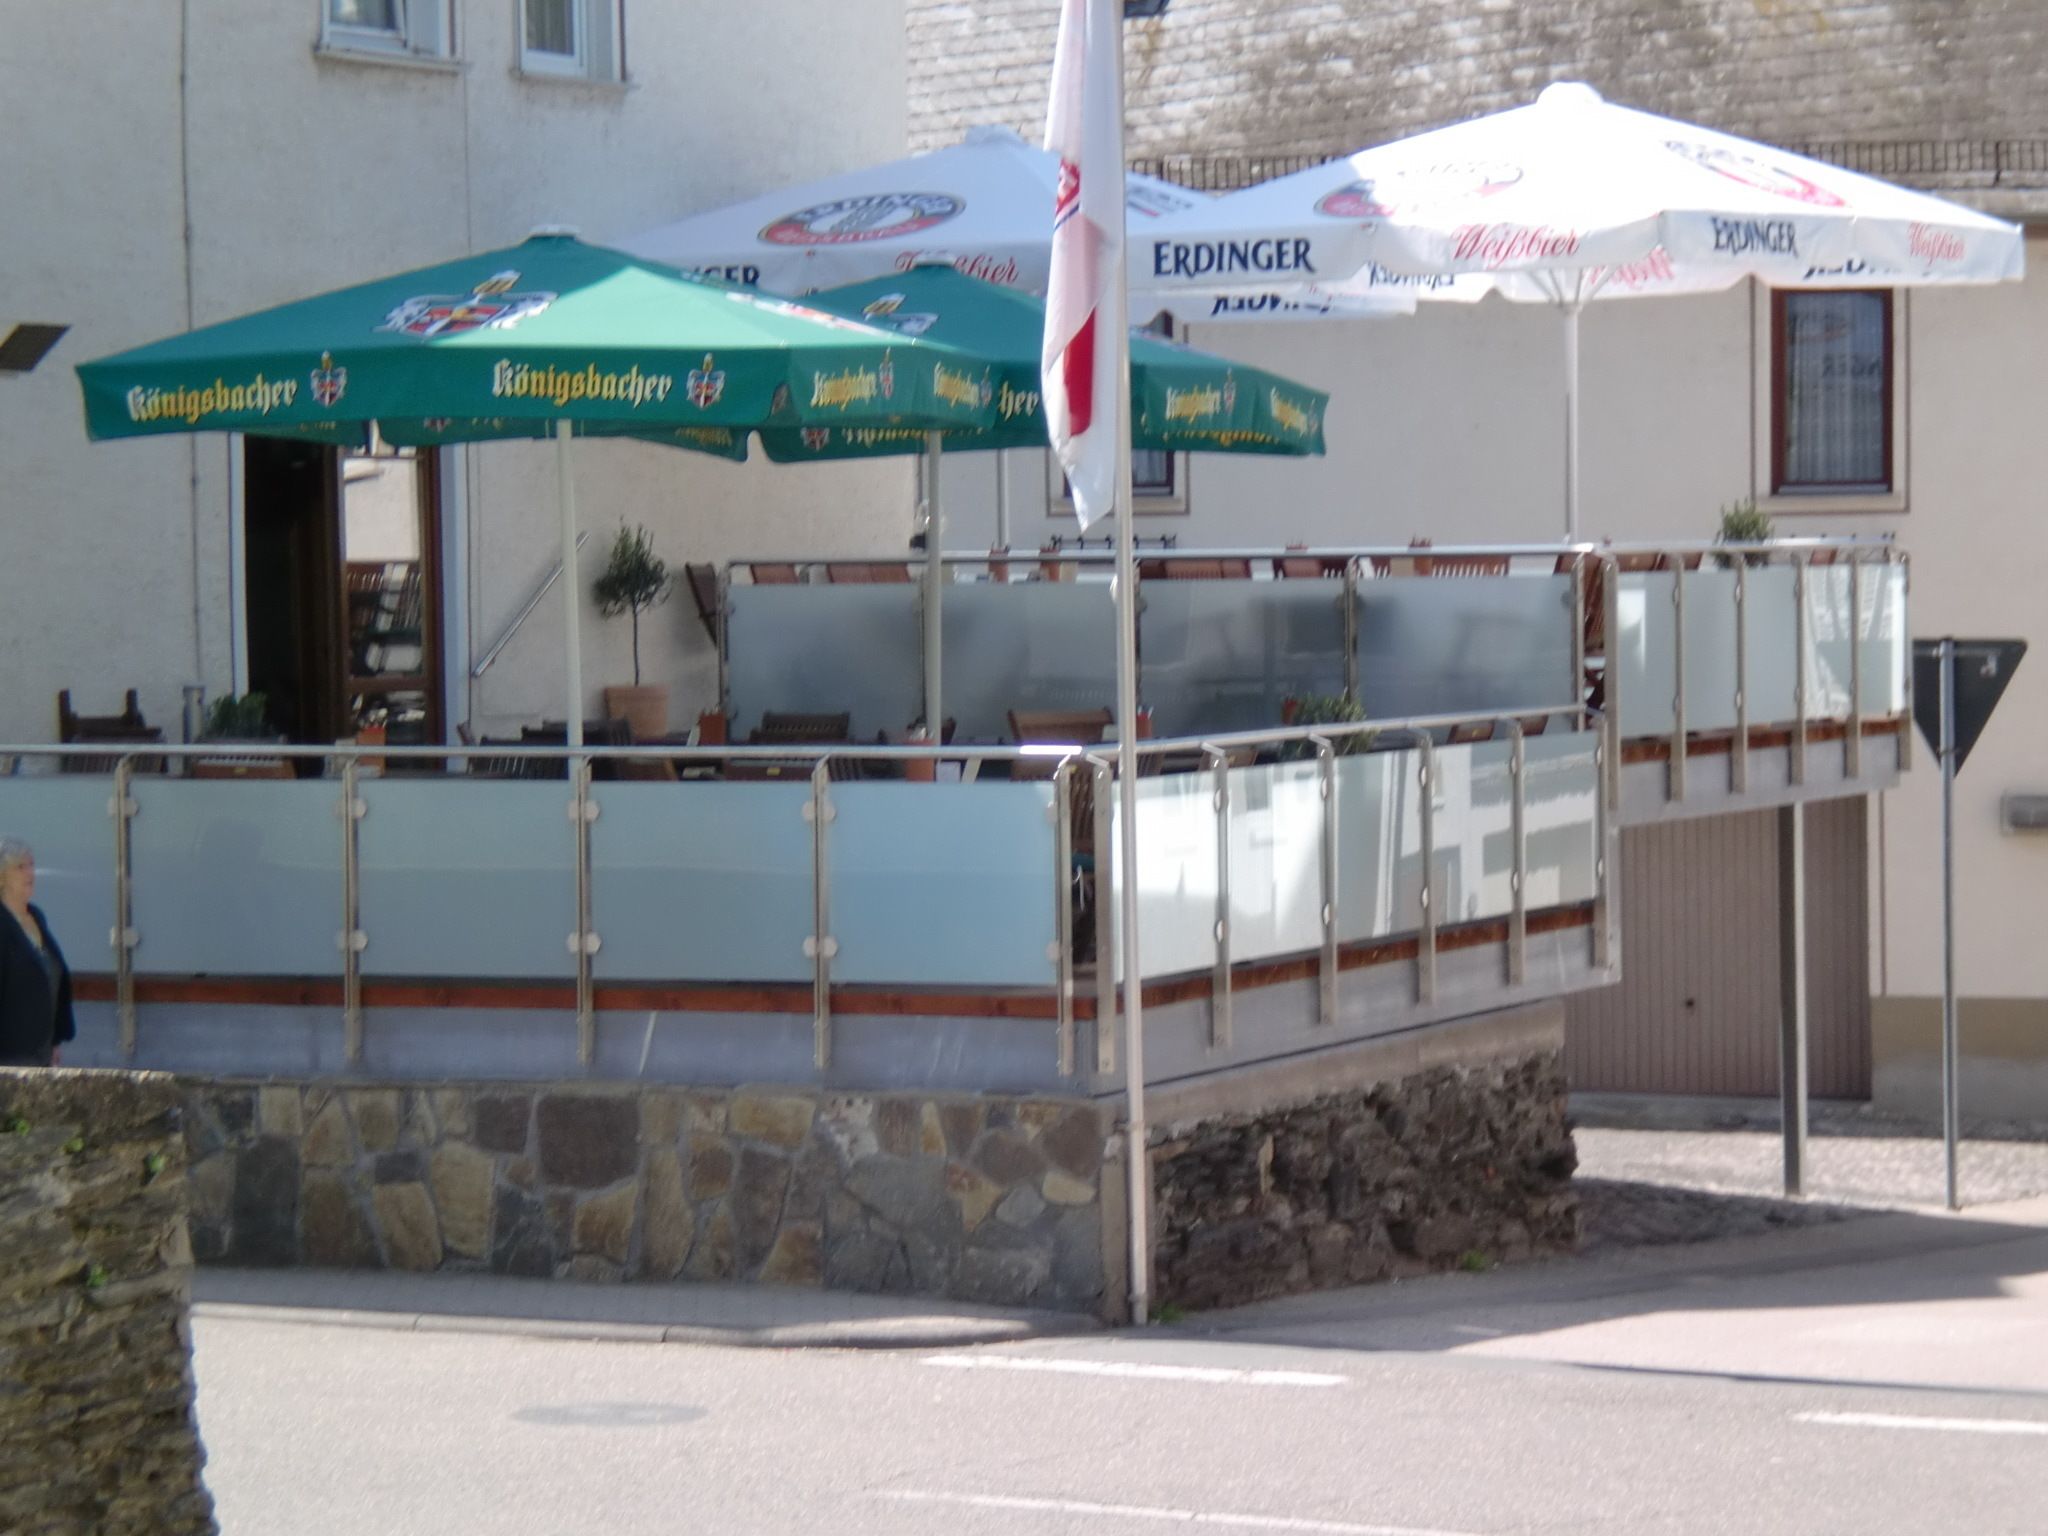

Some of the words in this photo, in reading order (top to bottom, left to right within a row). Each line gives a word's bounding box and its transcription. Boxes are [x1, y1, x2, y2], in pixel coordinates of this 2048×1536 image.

[1153, 238, 1317, 278] ERDINGER
[1450, 222, 1580, 270] Weißbier
[1711, 217, 1799, 259] ERDINGER
[127, 372, 298, 423] Königsbacher
[492, 357, 672, 408] Königsbacher
